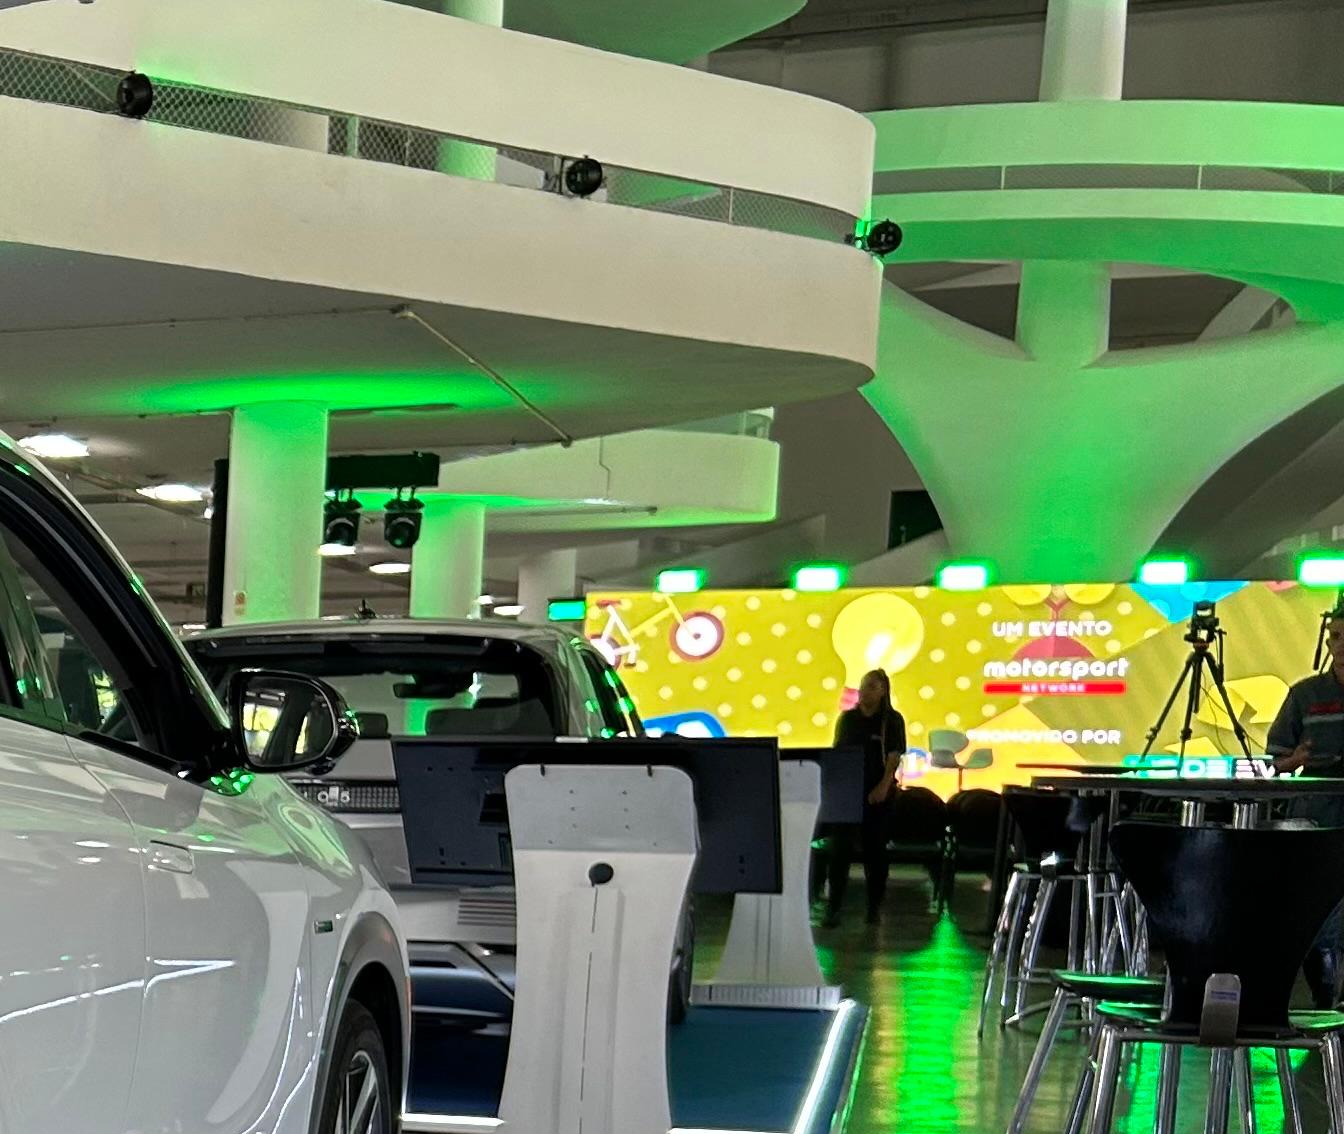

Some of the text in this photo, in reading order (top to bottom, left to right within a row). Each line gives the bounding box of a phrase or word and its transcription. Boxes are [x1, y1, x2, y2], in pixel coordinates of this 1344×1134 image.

[992, 620, 1113, 637] UM EVENTO
[983, 657, 1130, 681] motorsport
[1081, 729, 1122, 745] POR
